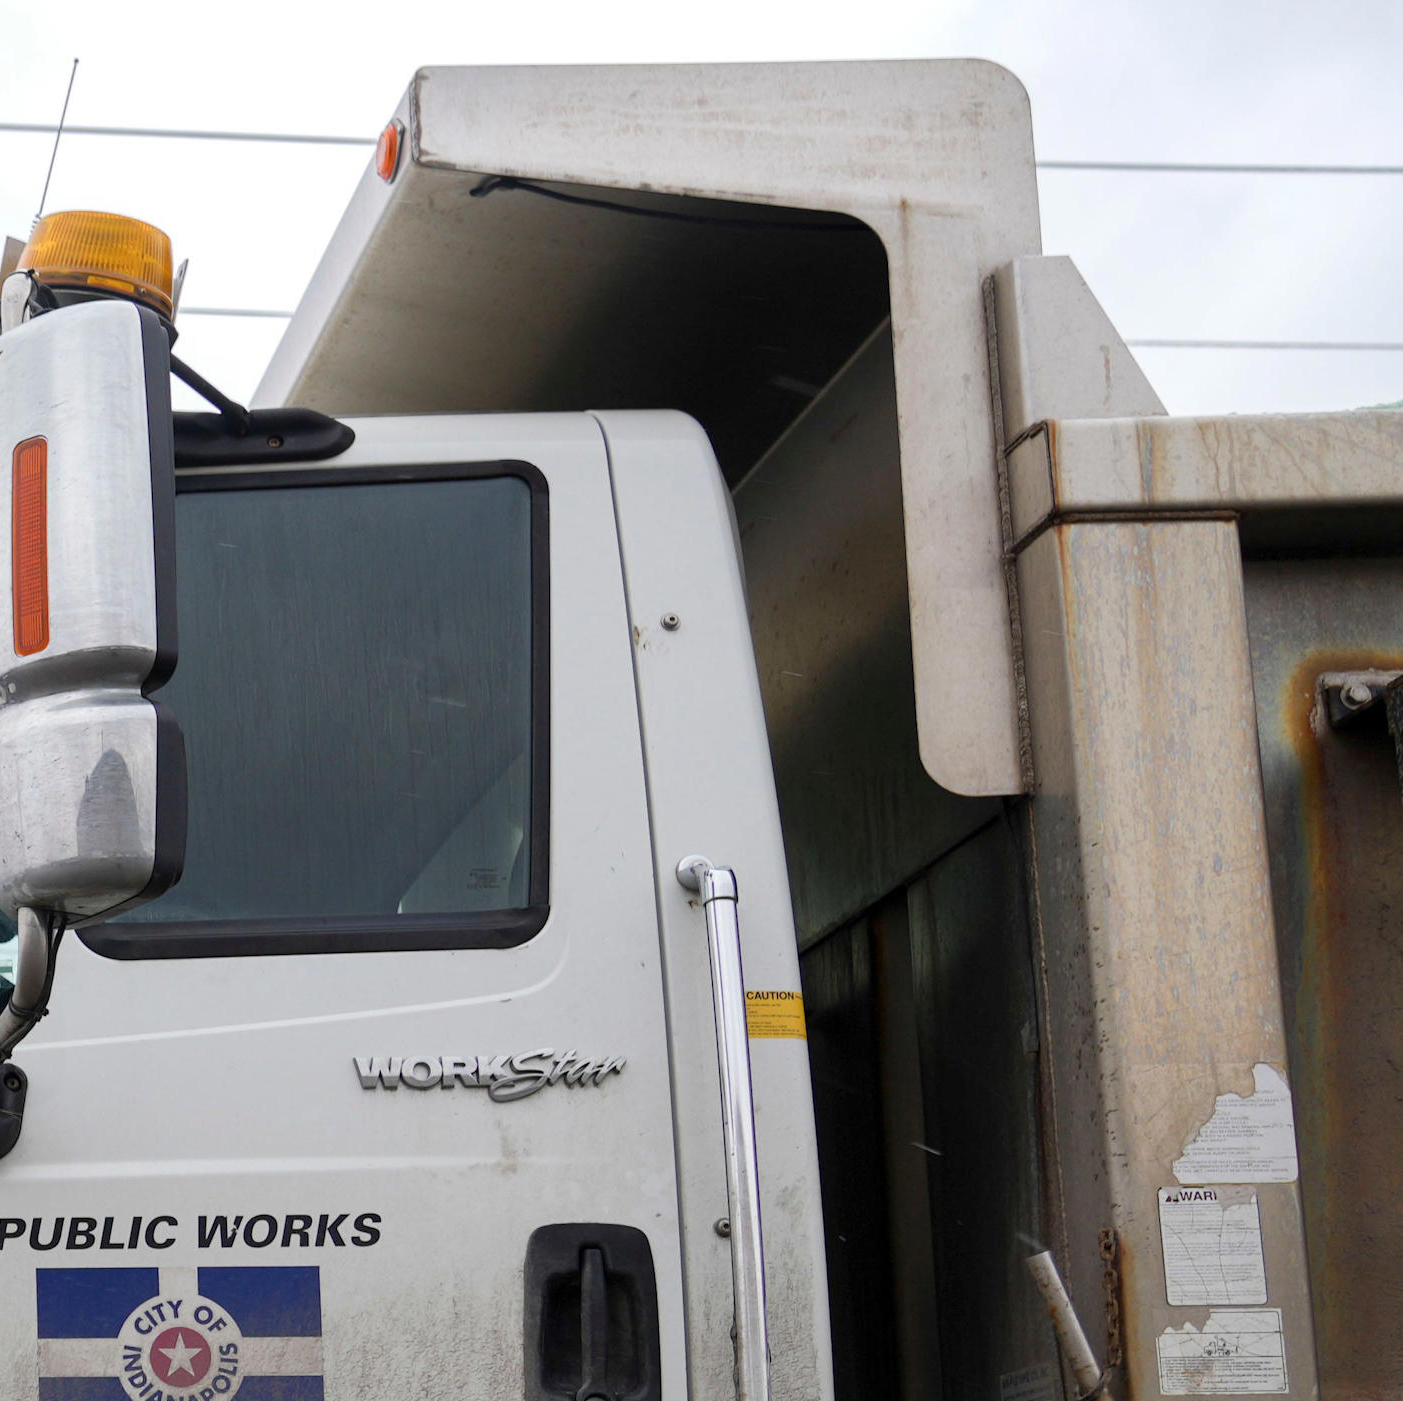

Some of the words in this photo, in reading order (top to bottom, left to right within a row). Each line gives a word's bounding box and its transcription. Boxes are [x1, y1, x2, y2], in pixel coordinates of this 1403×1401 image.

[746, 991, 794, 1001] CAUTION
[197, 1212, 382, 1249] WORKS
[134, 1300, 183, 1335] CITY
[194, 1306, 228, 1332] OF
